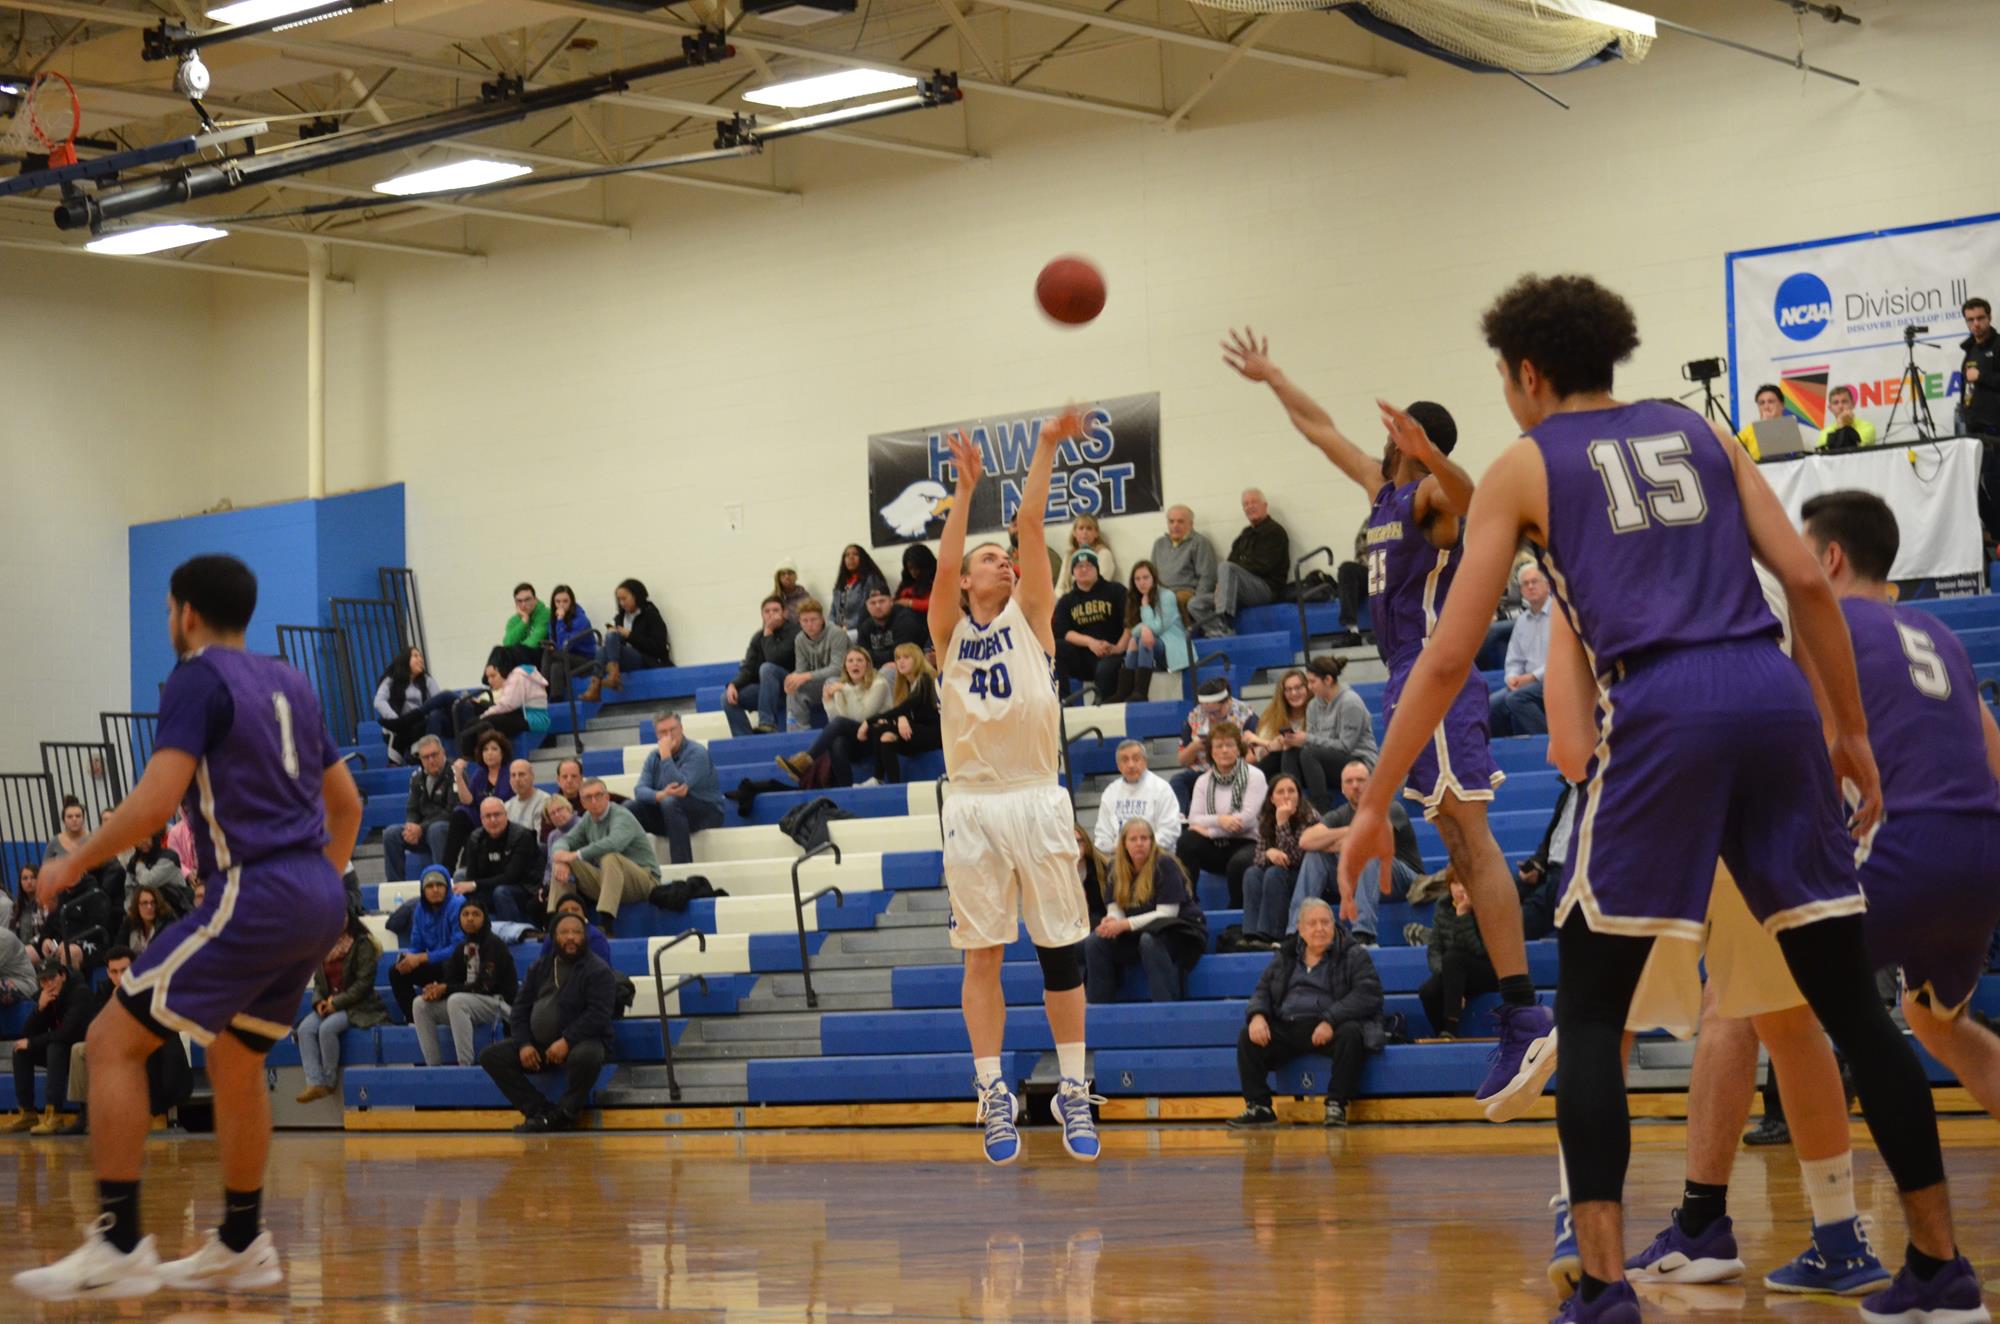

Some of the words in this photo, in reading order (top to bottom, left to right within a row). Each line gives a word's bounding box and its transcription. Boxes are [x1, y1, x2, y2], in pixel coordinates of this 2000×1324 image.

[1780, 302, 1832, 327] NCAA
[1845, 285, 1942, 321] Division
[1950, 277, 1968, 306] III
[1846, 319, 1892, 333] DISCOVER
[1897, 312, 1940, 327] DEVELOP
[1586, 431, 1709, 535] 15
[968, 662, 1013, 701] 40
[1893, 618, 1952, 701] 5
[271, 690, 300, 780] 1
